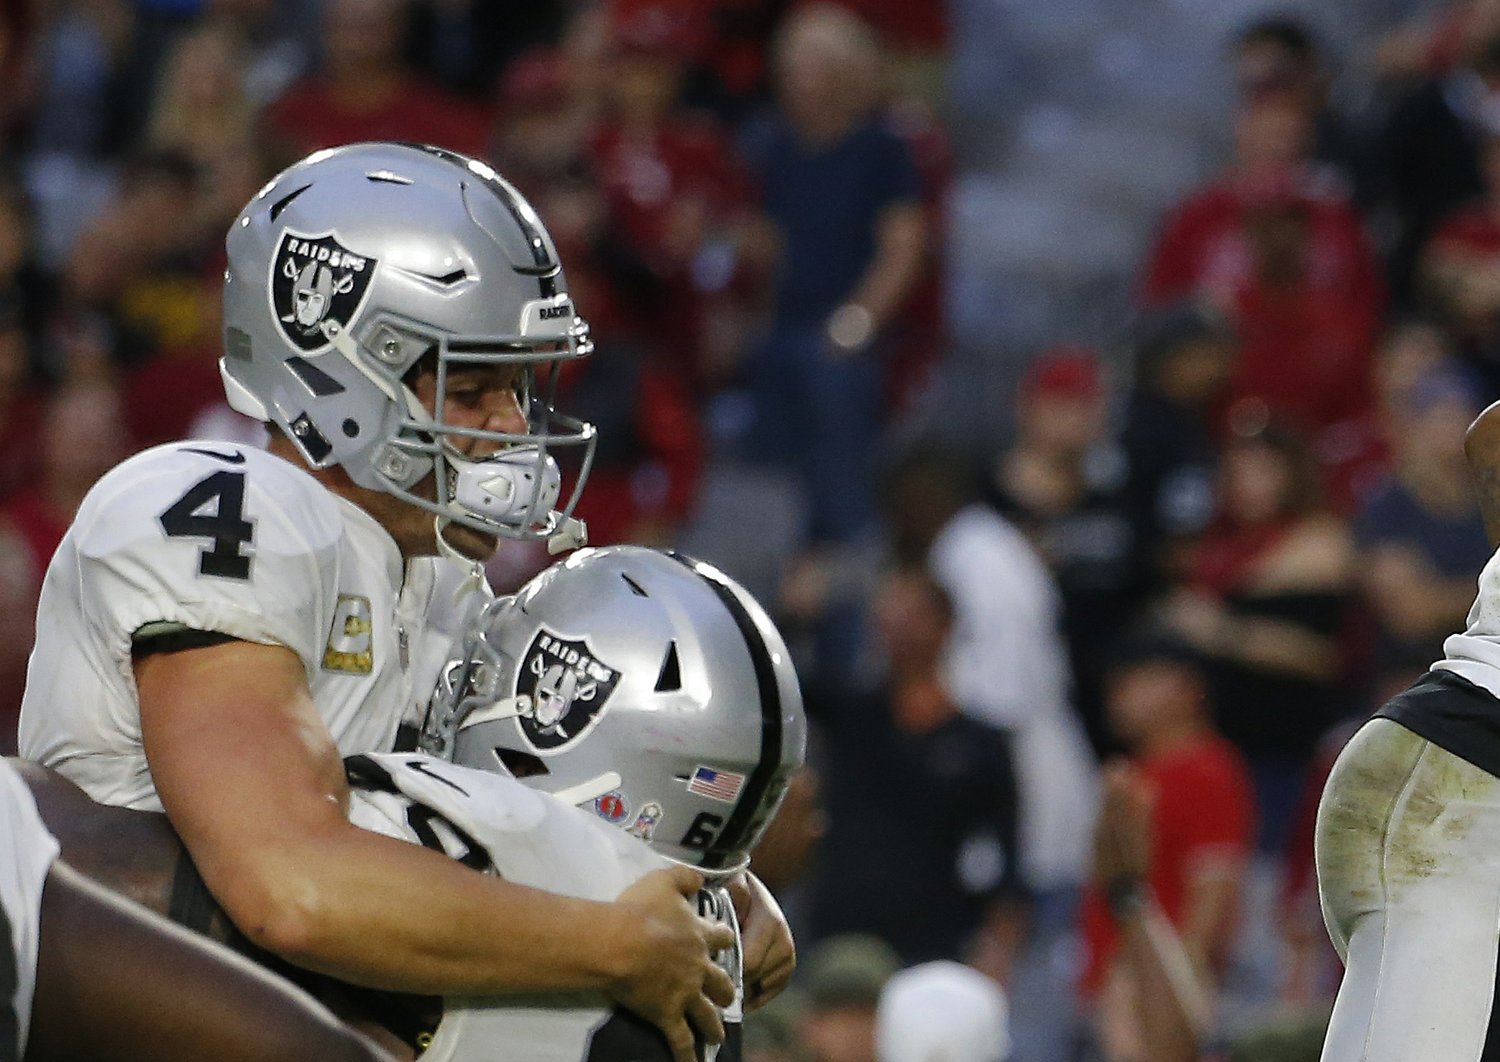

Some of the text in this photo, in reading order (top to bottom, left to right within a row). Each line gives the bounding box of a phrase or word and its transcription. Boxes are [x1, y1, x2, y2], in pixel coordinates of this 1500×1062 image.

[287, 239, 367, 272] RAIDERS
[161, 471, 254, 580] 4
[540, 636, 612, 682] RAIDERS
